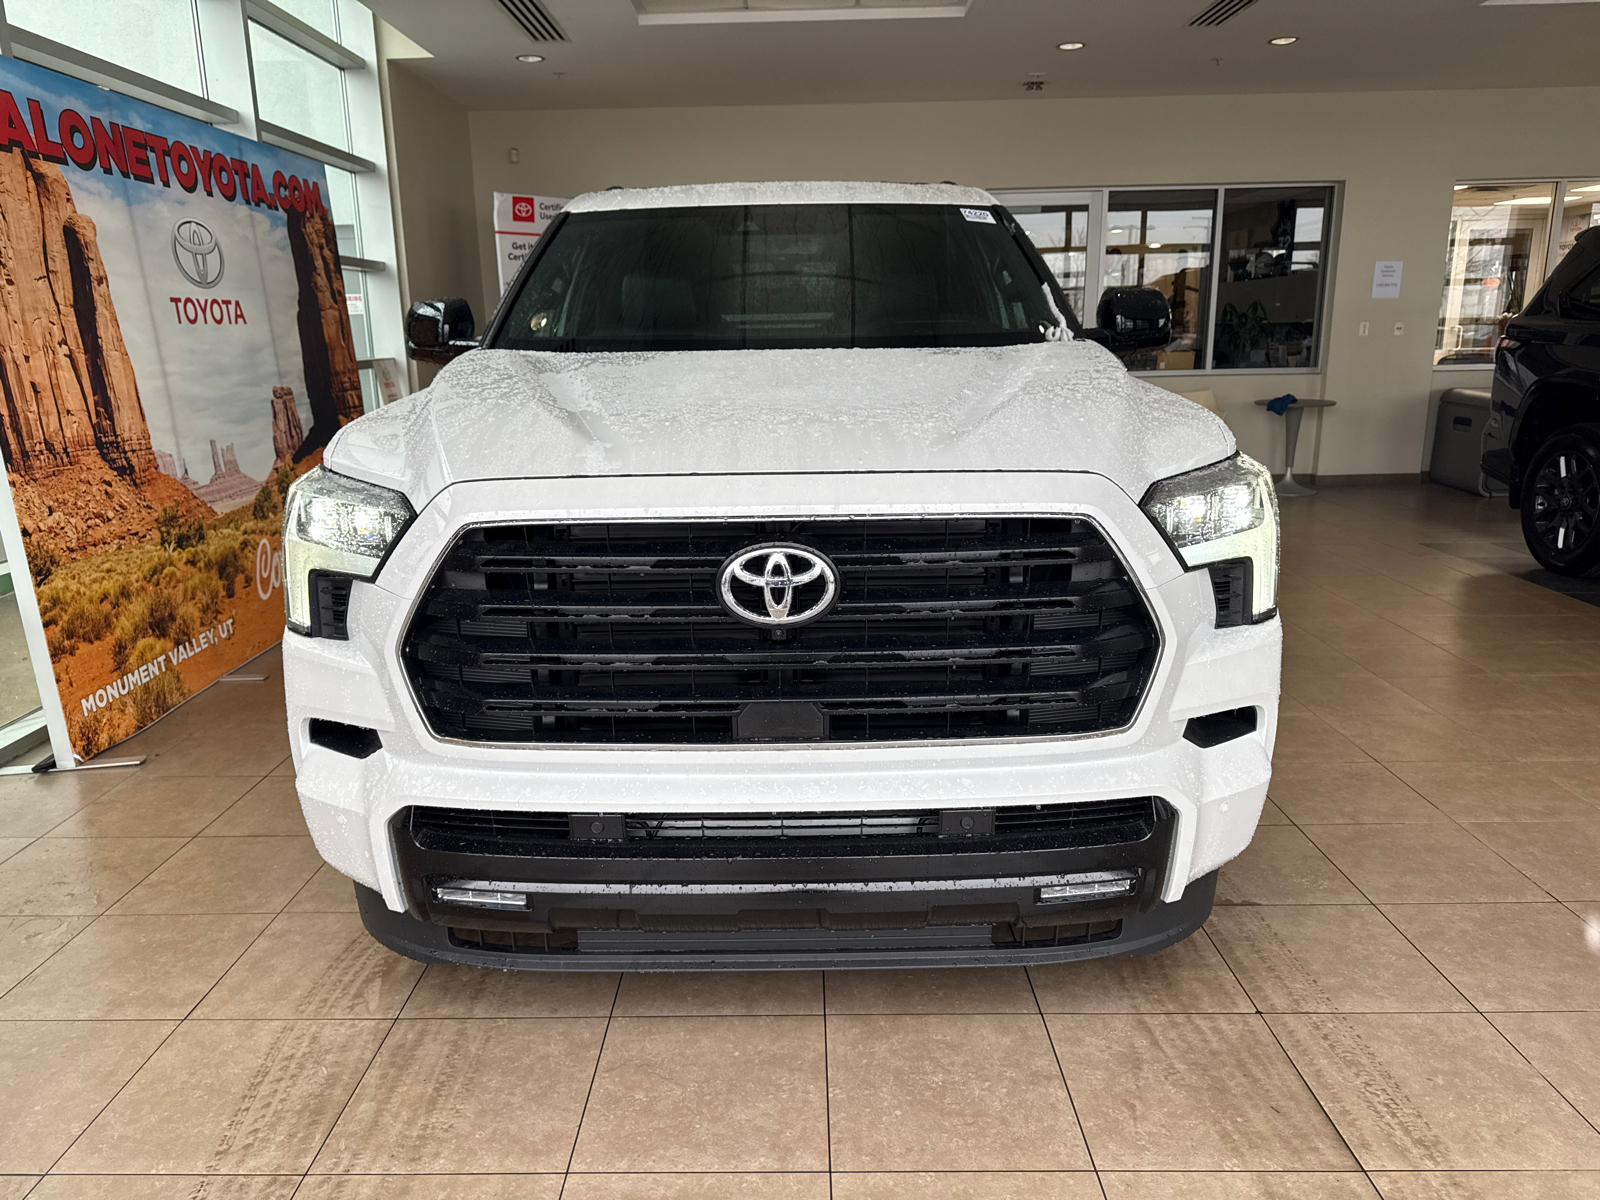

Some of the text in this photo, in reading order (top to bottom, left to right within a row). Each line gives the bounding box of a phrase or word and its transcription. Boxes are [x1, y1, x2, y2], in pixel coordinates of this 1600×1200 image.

[0, 88, 325, 217] ALONETOYOTA.COM
[512, 242, 526, 250] Get
[169, 297, 248, 325] TOYOTA
[80, 618, 235, 718] MONUMENT VALLEY, UT
